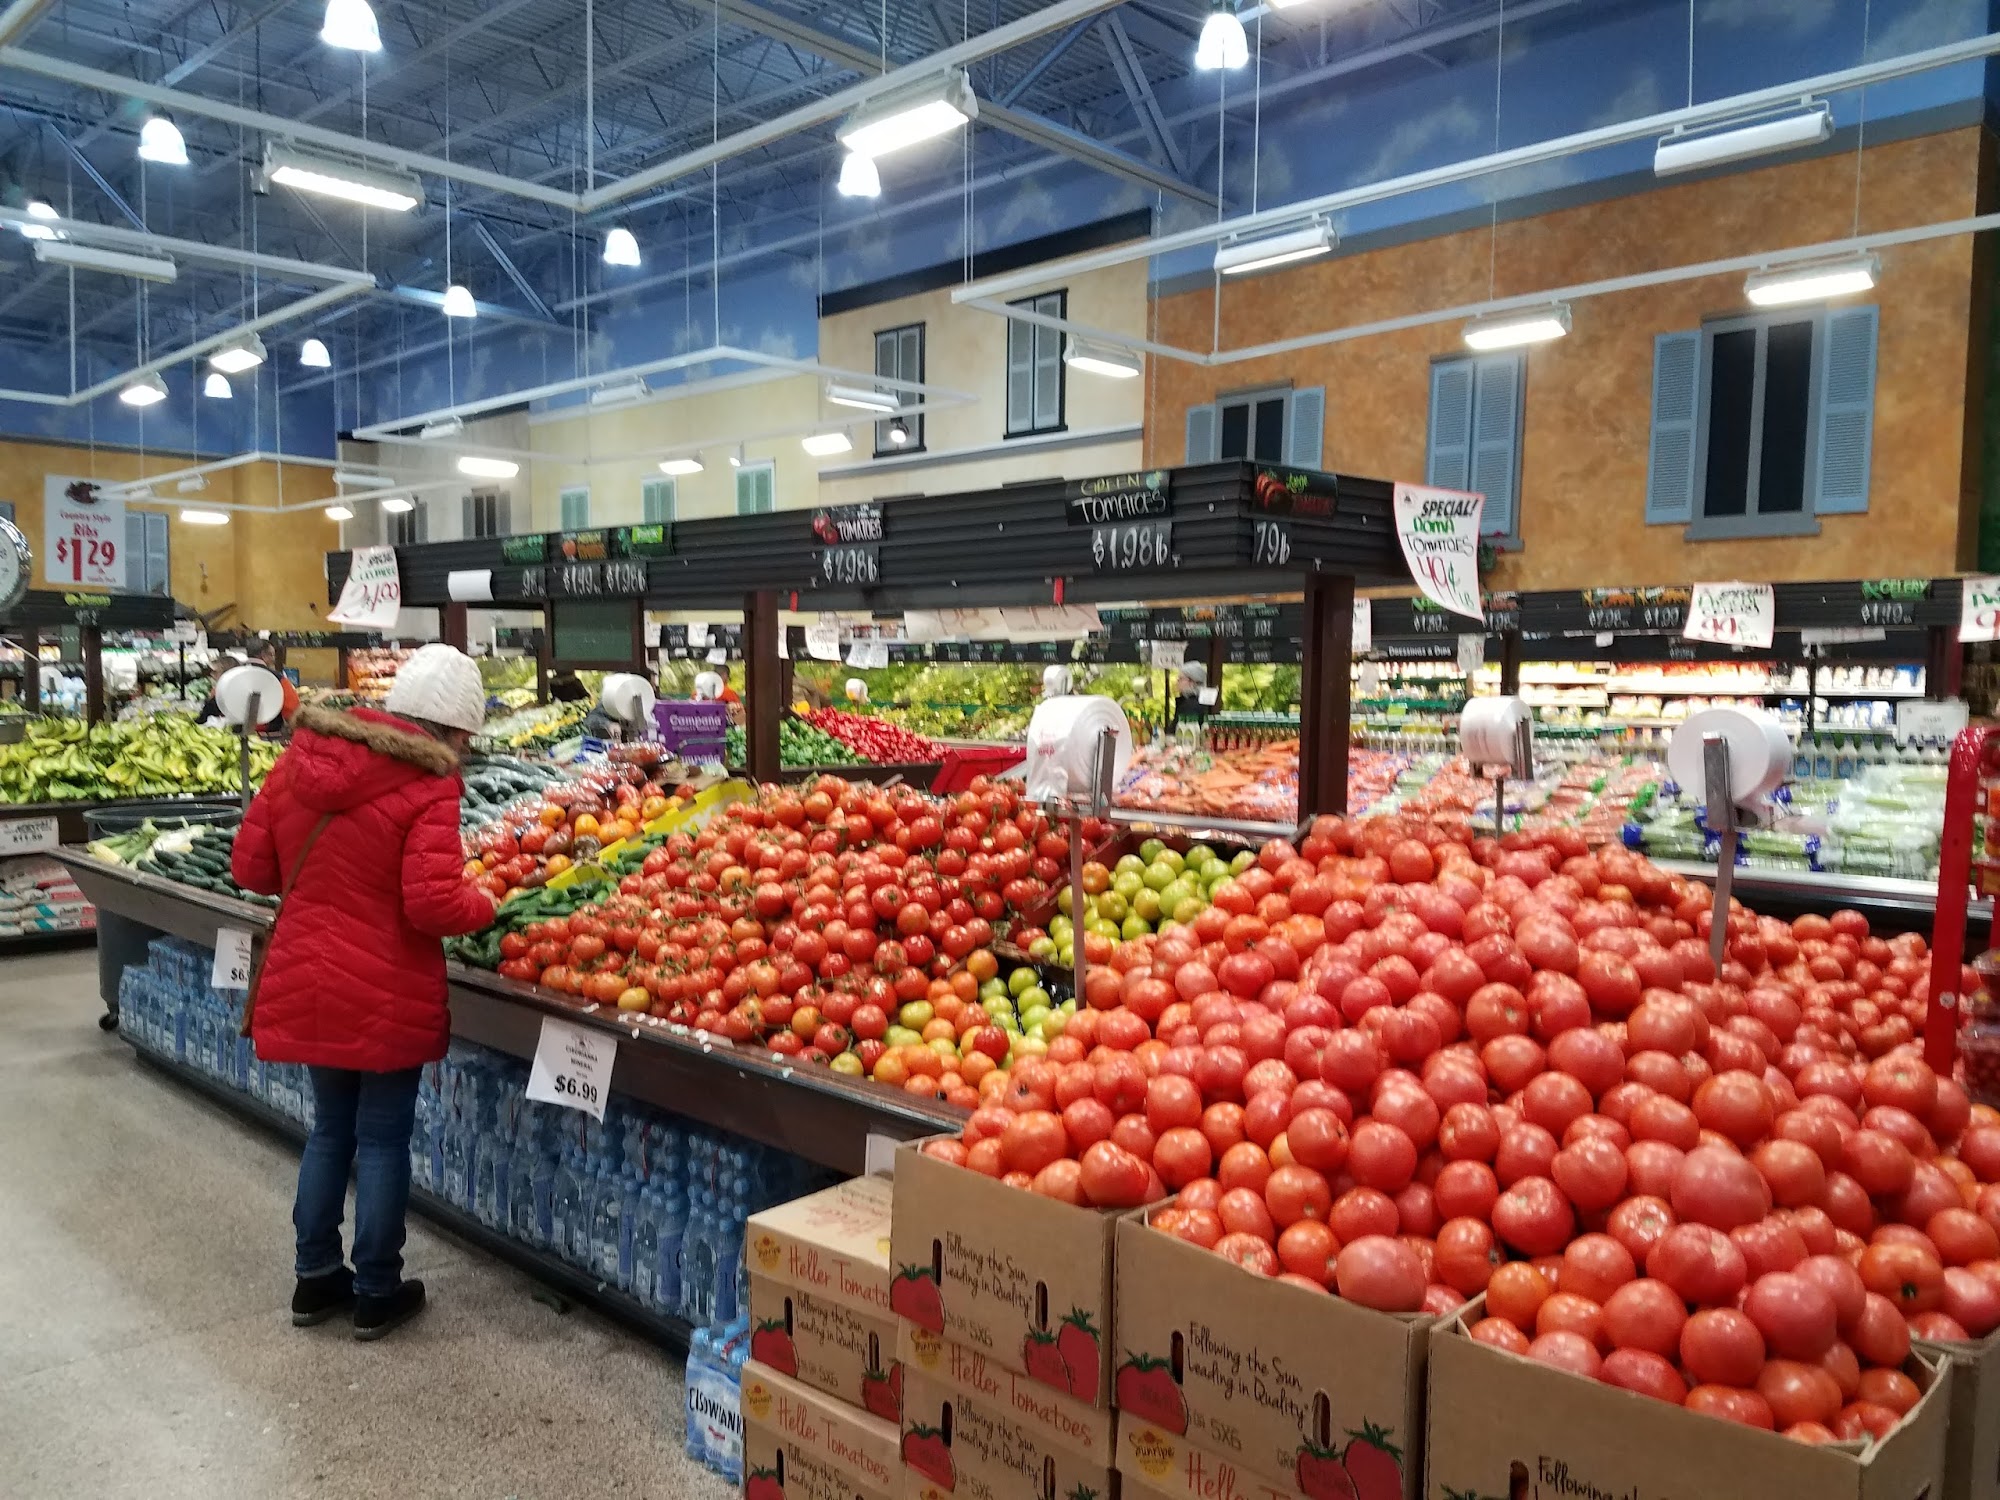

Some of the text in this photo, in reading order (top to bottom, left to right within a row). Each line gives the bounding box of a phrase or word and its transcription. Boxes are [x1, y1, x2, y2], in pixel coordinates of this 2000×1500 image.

[1421, 498, 1479, 517] SPECIAL!
[73, 522, 99, 538] Ribs
[836, 518, 882, 541] TOMATOES
[1880, 579, 1928, 595] CELERY
[554, 1074, 598, 1104] $6.99
[946, 1231, 984, 1272] Following
[987, 1248, 1003, 1273] the
[788, 1244, 889, 1308] Heller Tomato
[944, 1254, 979, 1299] Leading
[981, 1279, 990, 1292] in
[796, 1309, 824, 1347] Leading
[797, 1290, 828, 1326] Following
[831, 1305, 844, 1325] the
[1189, 1321, 1241, 1374] Following
[1246, 1347, 1269, 1376] the
[1187, 1347, 1234, 1400] Leading
[1239, 1380, 1250, 1396] in
[950, 1343, 1092, 1447] Heller Tomatoes
[957, 1394, 994, 1440] Following
[998, 1416, 1012, 1441] the
[777, 1396, 889, 1484] Heller Tomatoes
[955, 1416, 989, 1461] Leading
[991, 1445, 1000, 1458] in
[787, 1461, 814, 1498] Leading
[788, 1443, 818, 1482] Following
[820, 1461, 832, 1482] the
